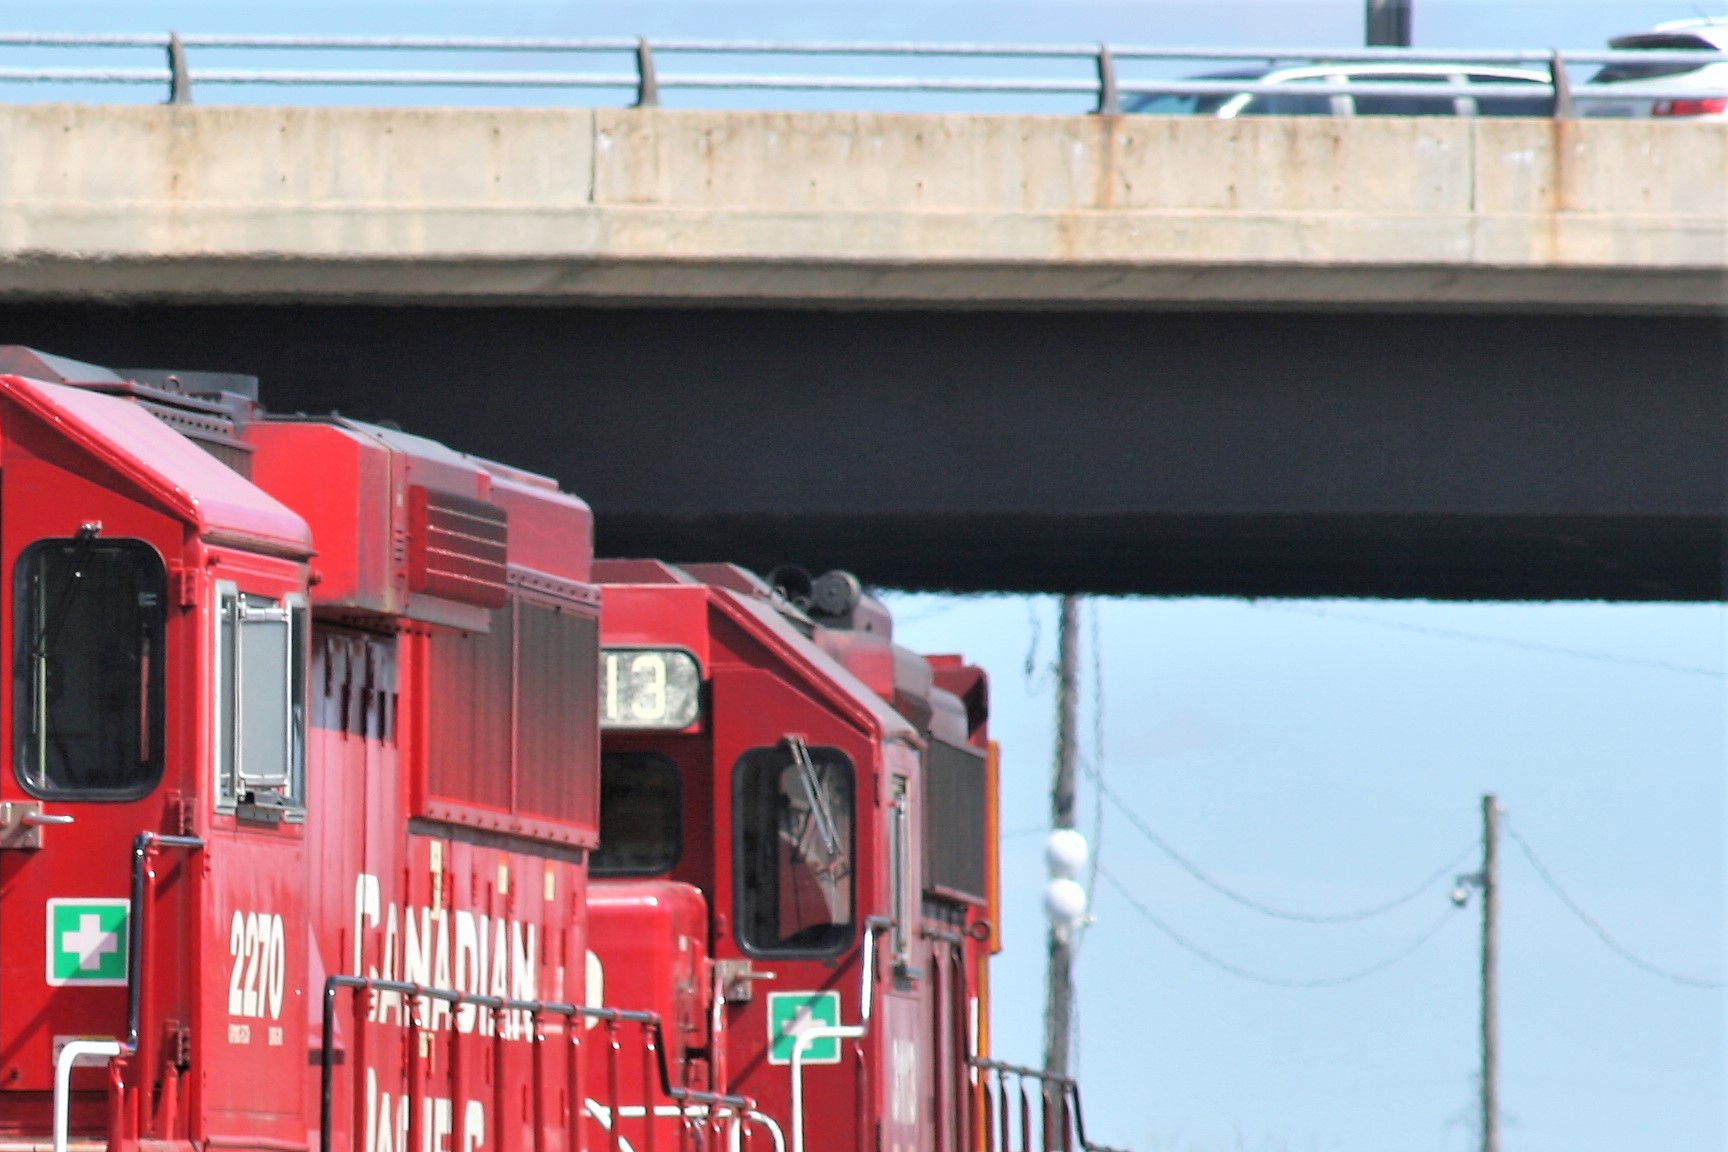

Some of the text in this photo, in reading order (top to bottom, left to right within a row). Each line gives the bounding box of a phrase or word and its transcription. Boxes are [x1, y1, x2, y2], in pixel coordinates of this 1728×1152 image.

[605, 654, 667, 720] 13
[228, 909, 285, 1021] 2270
[354, 873, 537, 1043] CANADIAN
